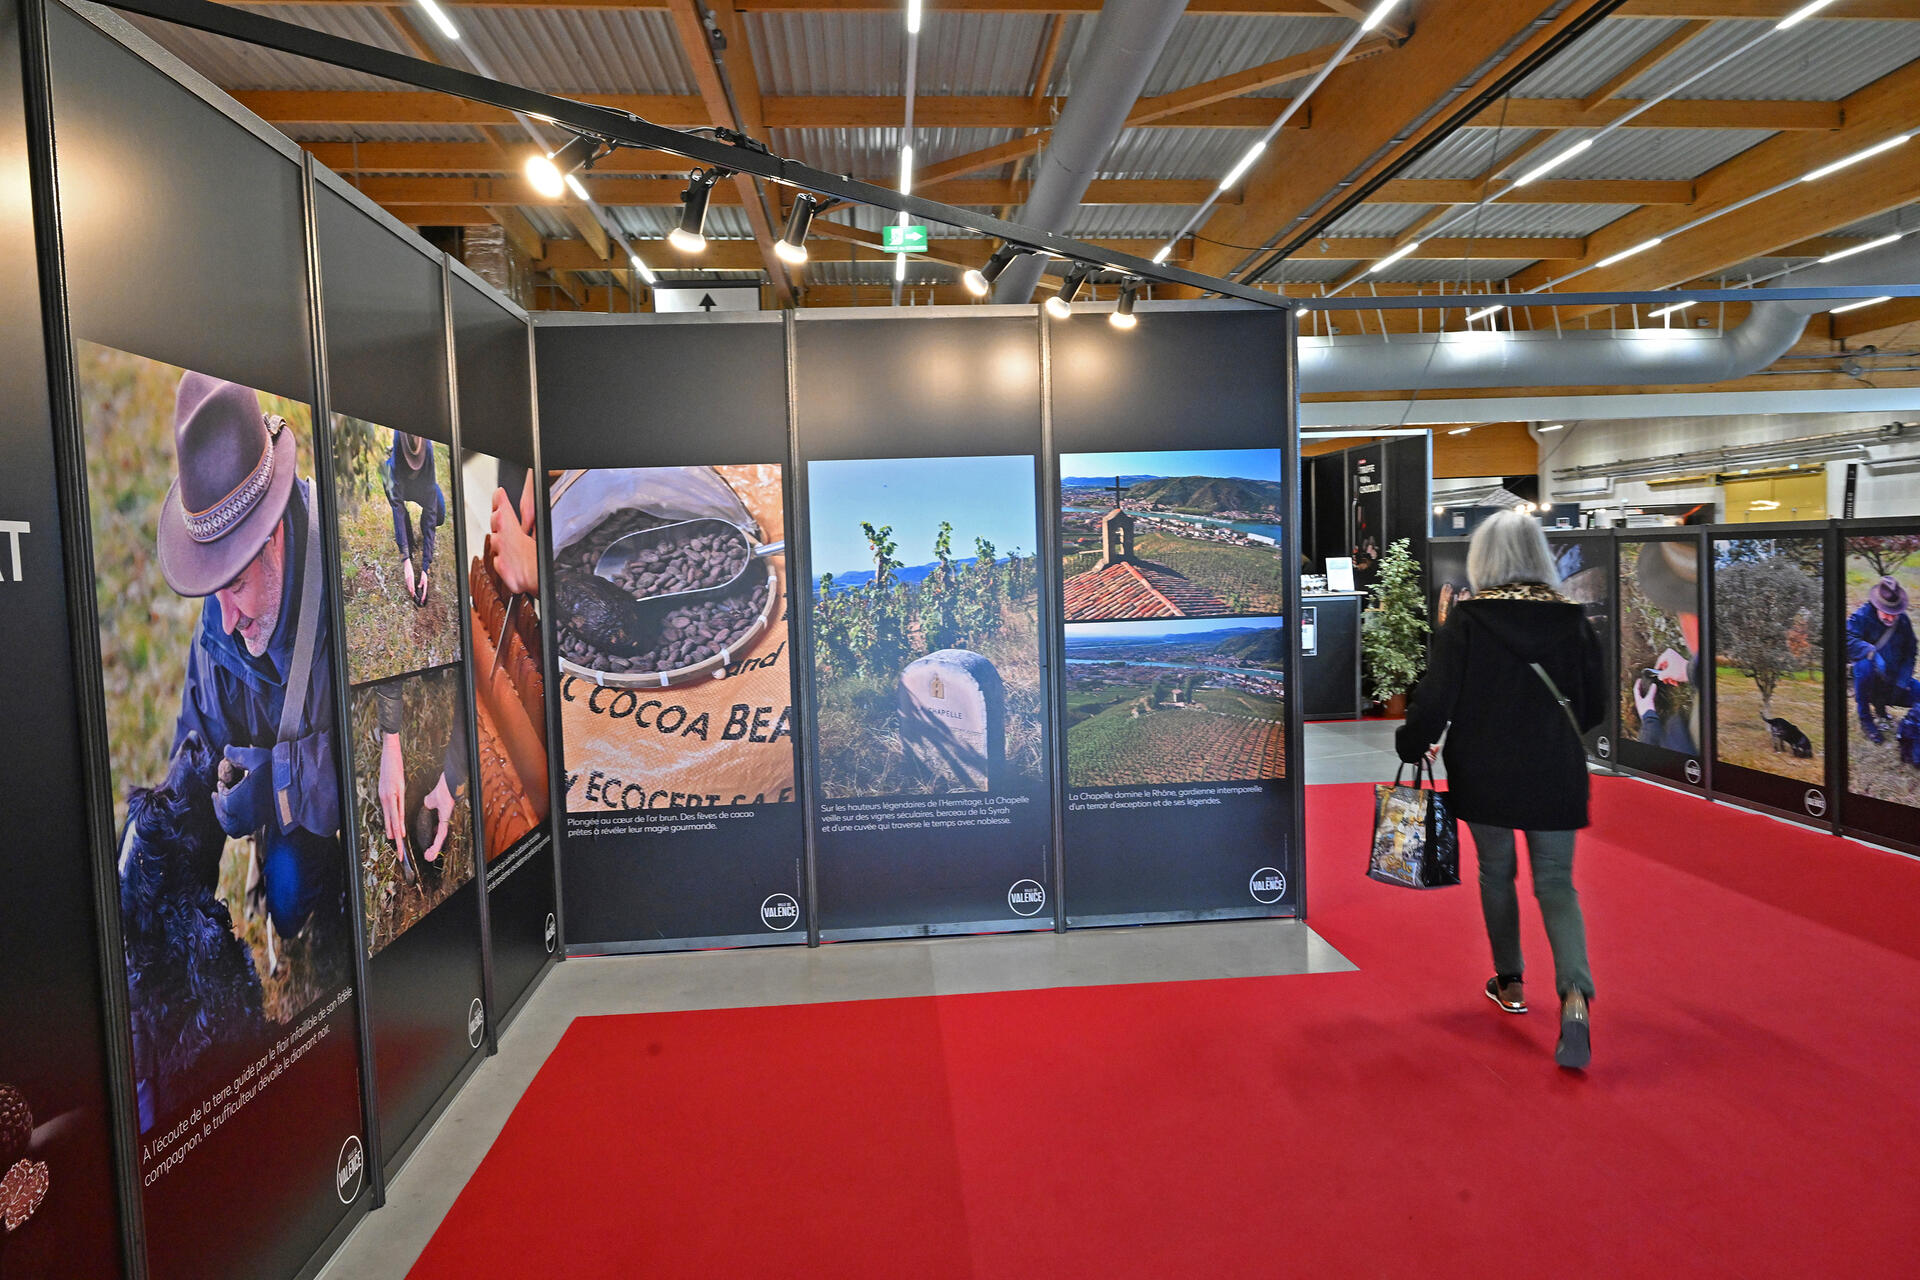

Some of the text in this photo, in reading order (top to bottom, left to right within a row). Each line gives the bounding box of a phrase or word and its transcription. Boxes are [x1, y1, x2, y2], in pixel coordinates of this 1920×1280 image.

[0, 520, 31, 581] T
[725, 641, 786, 678] and
[588, 685, 710, 741] COCOA
[721, 703, 793, 744] BEA
[1068, 793, 1079, 801] La
[1080, 792, 1113, 801] Chapelle
[1114, 790, 1143, 798] domine
[1144, 790, 1150, 798] le
[1178, 788, 1216, 798] gardienne
[1216, 785, 1263, 795] intemporelle
[820, 804, 834, 812] Sur
[835, 804, 846, 812] les
[848, 802, 881, 811] hauteurs
[882, 801, 926, 811] légendaires
[996, 796, 1030, 805] Chapelle
[1068, 803, 1086, 811] d'un
[1086, 802, 1108, 810] terroir
[1110, 800, 1152, 810] d'exception
[1186, 798, 1222, 807] légendes.
[567, 818, 599, 828] Plongée
[612, 816, 633, 824] cœur
[659, 814, 678, 822] brun.
[680, 812, 696, 820] Des
[696, 812, 718, 820] fèves
[718, 811, 729, 819] de
[822, 814, 841, 822] veille
[870, 812, 896, 821] vignes
[936, 808, 967, 816] berceau
[968, 808, 978, 816] de
[988, 806, 1010, 816] Syrah
[568, 828, 592, 838] prêtes
[600, 826, 627, 834] révéler
[628, 826, 643, 834] leur
[644, 824, 670, 834] magie
[670, 822, 718, 833] gourmande.
[832, 824, 853, 832] d'une
[878, 823, 890, 831] qui
[923, 820, 930, 828] le
[932, 820, 956, 828] temps
[976, 817, 1012, 825] noblesse.
[1253, 880, 1284, 890] VALENCE
[1011, 892, 1042, 903] VALENCE
[764, 906, 796, 918] VALENCE
[142, 1145, 152, 1165] À
[152, 1120, 189, 1156] l'écoute
[190, 1108, 202, 1126] de
[202, 1100, 211, 1116] la
[234, 1064, 256, 1094] guidé
[256, 1055, 268, 1075] par
[268, 1048, 276, 1061] le
[276, 1036, 290, 1055] flair
[290, 1014, 318, 1045] infaillible
[318, 1008, 327, 1022] de
[326, 1000, 338, 1014] son
[338, 986, 353, 1006] fidèle
[203, 1122, 212, 1138] le
[212, 1084, 258, 1130] trufficulteur
[258, 1062, 283, 1091] dévoile
[283, 1056, 290, 1070] le
[290, 1033, 318, 1064] diamant
[339, 1150, 362, 1188] VALENCE
